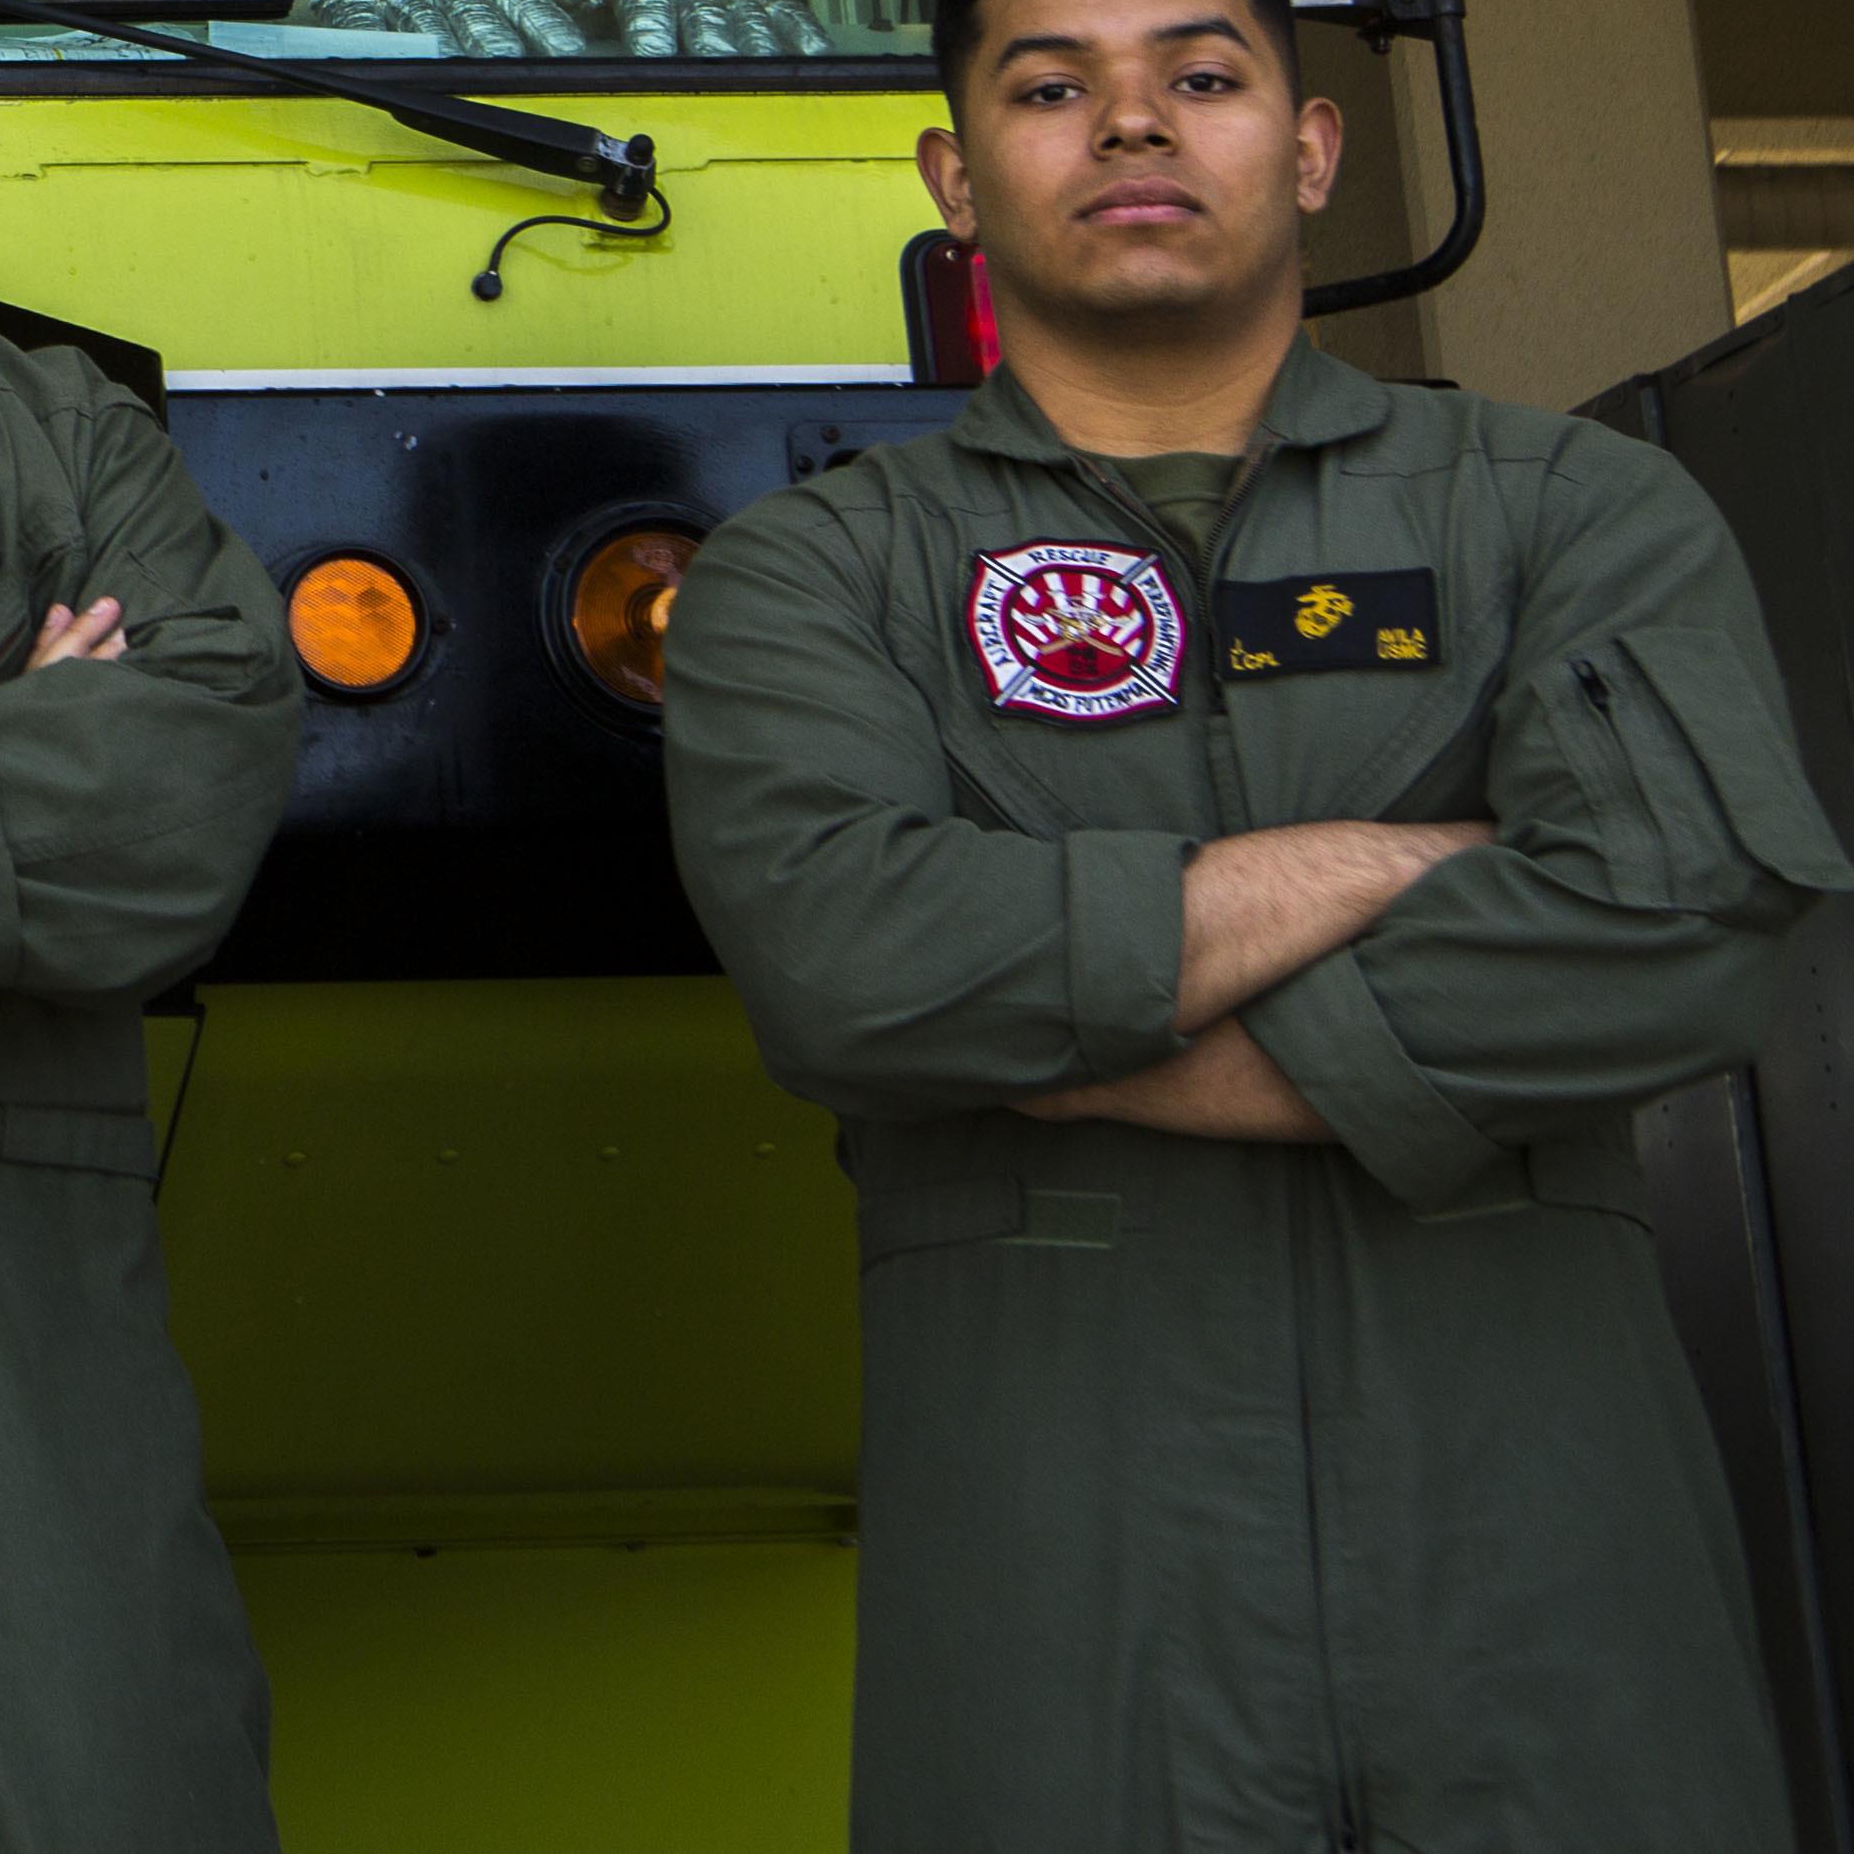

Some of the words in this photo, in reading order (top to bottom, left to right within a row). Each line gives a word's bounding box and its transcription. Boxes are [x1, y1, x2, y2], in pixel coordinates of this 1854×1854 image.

[1027, 548, 1111, 565] RESCUE
[978, 580, 1015, 667] AIRCRAFT
[1230, 650, 1281, 671] LCPL
